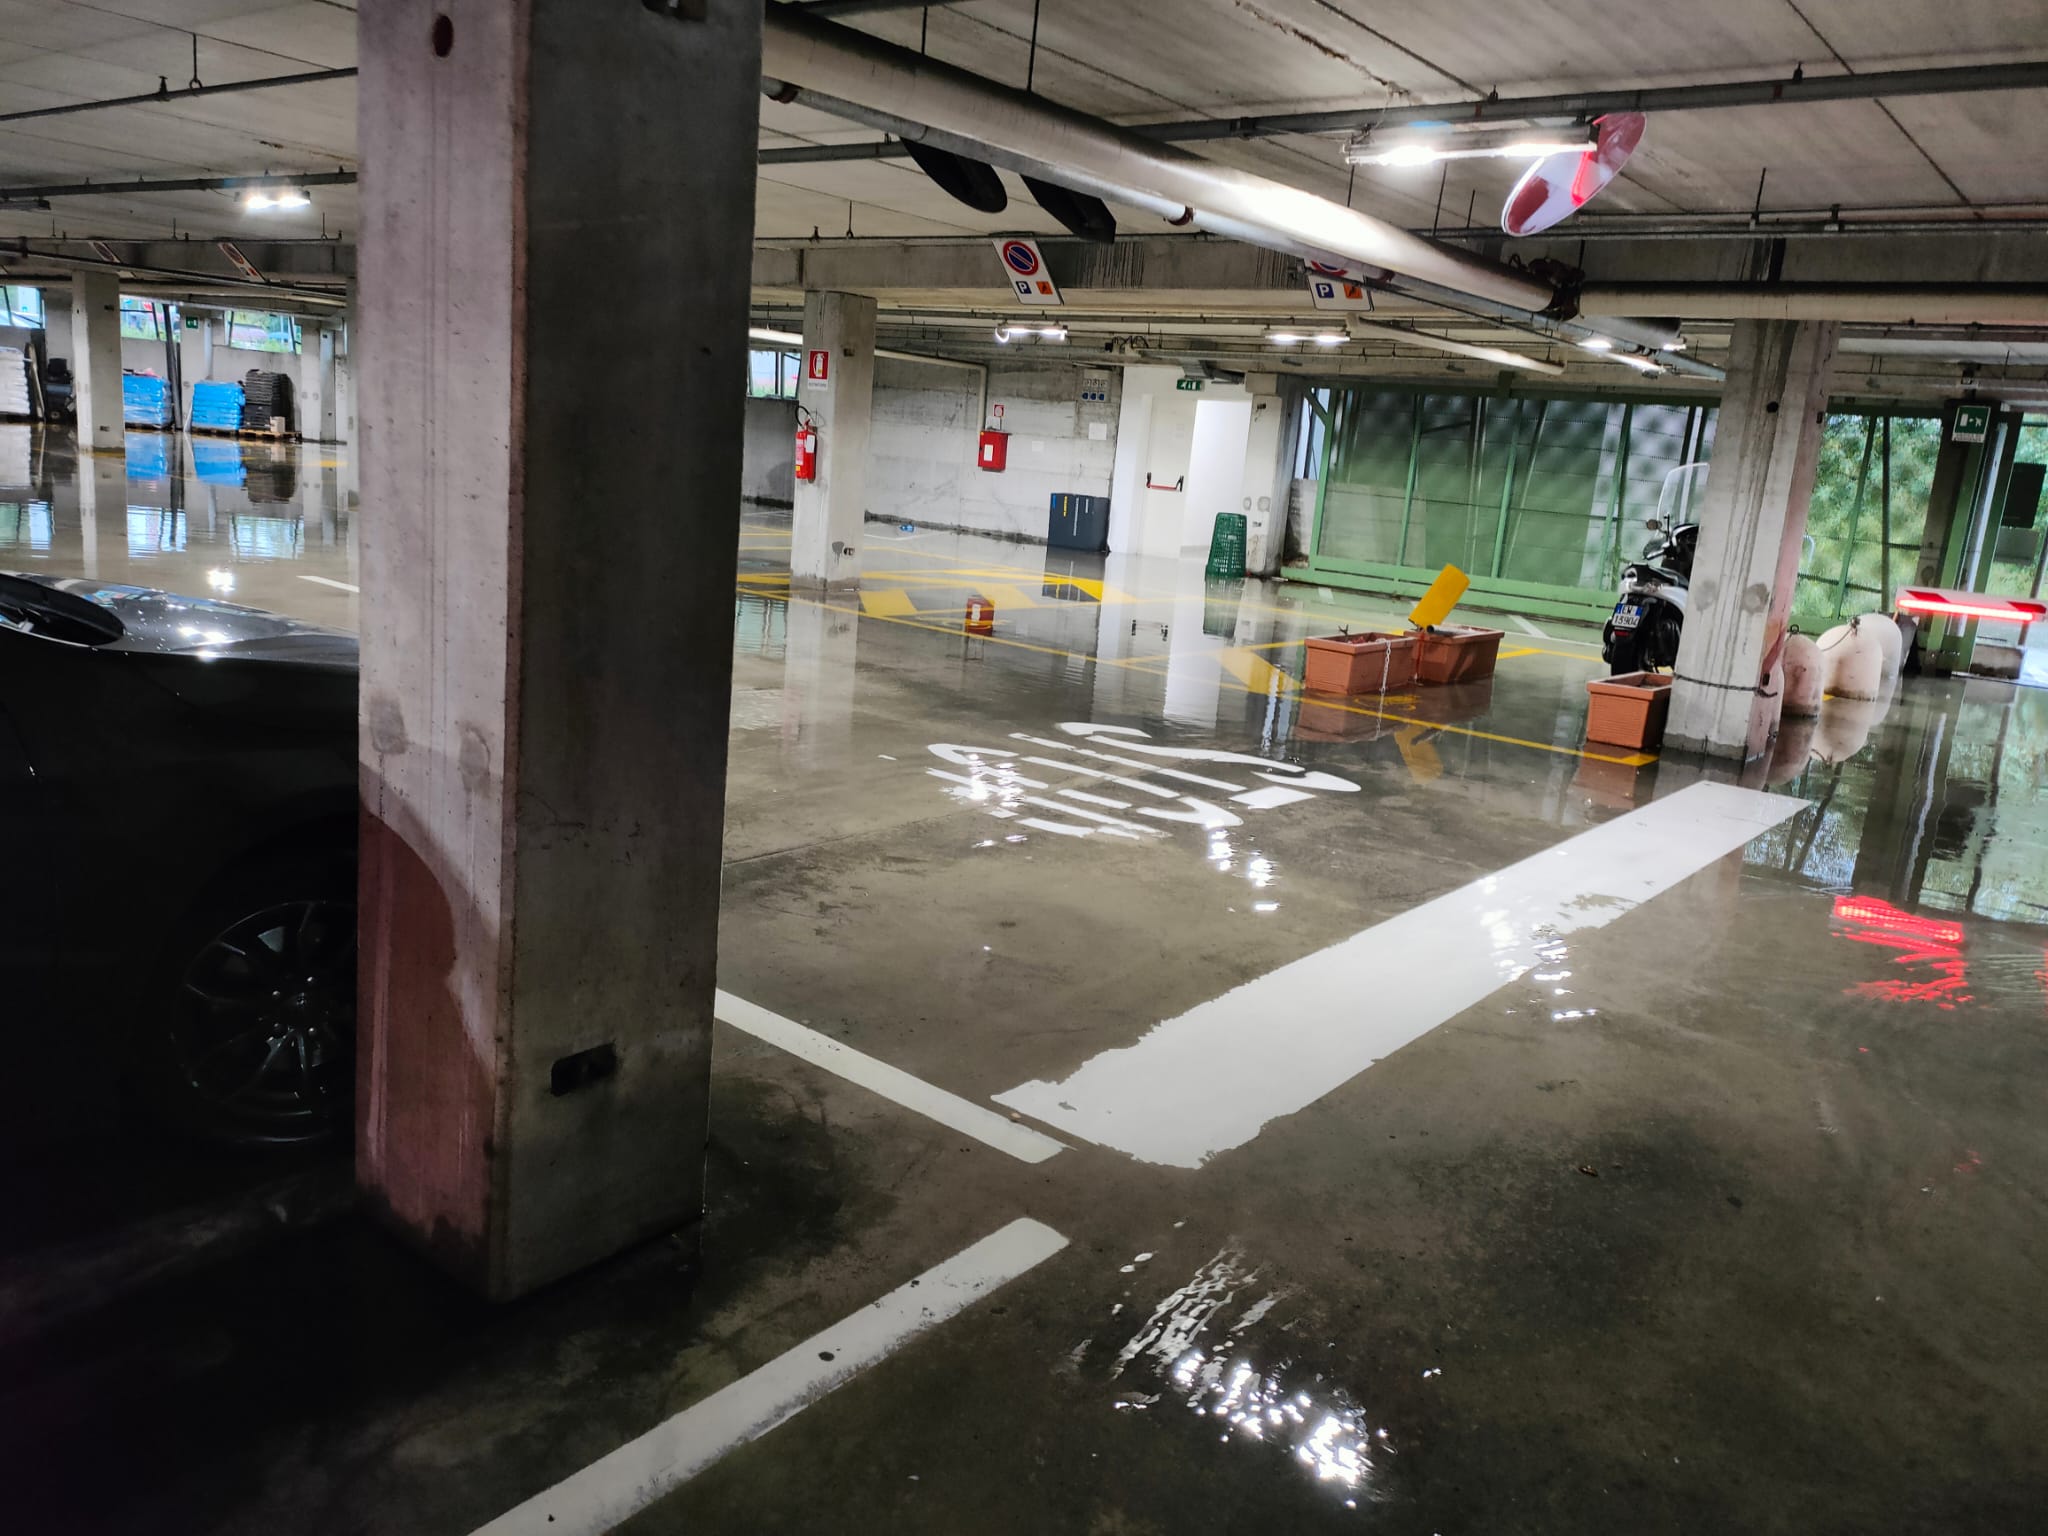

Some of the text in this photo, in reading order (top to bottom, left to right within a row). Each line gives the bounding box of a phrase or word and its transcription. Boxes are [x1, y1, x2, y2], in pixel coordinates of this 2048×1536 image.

[1018, 282, 1027, 293] P
[1319, 285, 1330, 296] P
[926, 722, 1361, 838] STOP
